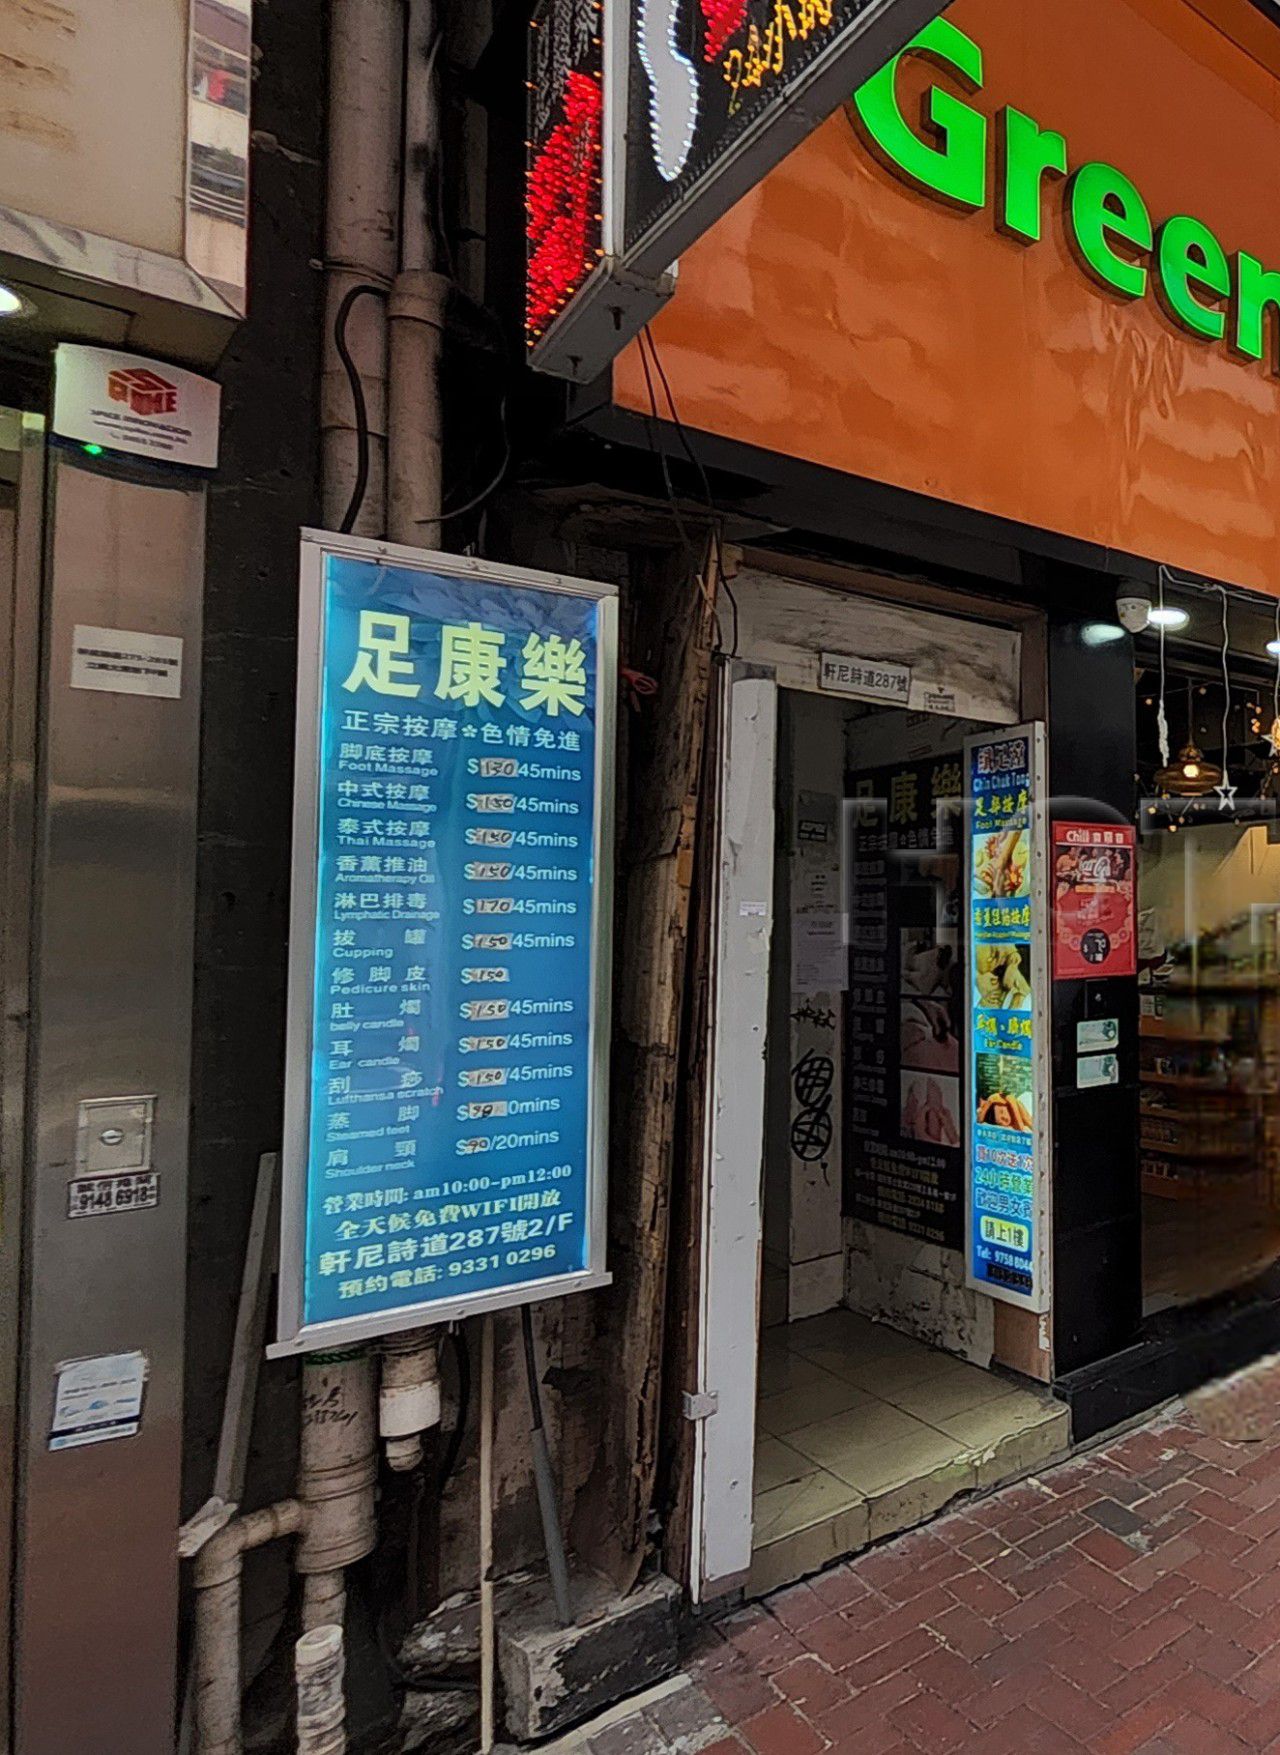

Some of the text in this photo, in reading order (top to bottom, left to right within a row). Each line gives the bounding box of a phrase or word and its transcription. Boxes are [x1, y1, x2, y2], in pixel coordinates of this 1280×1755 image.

[341, 609, 587, 717] 足康樂
[823, 662, 909, 693] 軒尼詩道287號
[341, 710, 581, 751] 正宗按摩 色情免進
[339, 760, 438, 778] Foot Massage
[337, 780, 430, 801] 中式按摩
[337, 817, 430, 837] 泰式按摩
[338, 835, 436, 849] Thai Massage
[334, 892, 427, 909] 淋巴排毒
[333, 946, 394, 959] Cupping
[330, 982, 431, 996] Pedicure skin
[329, 1058, 353, 1070] Ear
[448, 1252, 500, 1276] 9331
[506, 1243, 556, 1267] 0296
